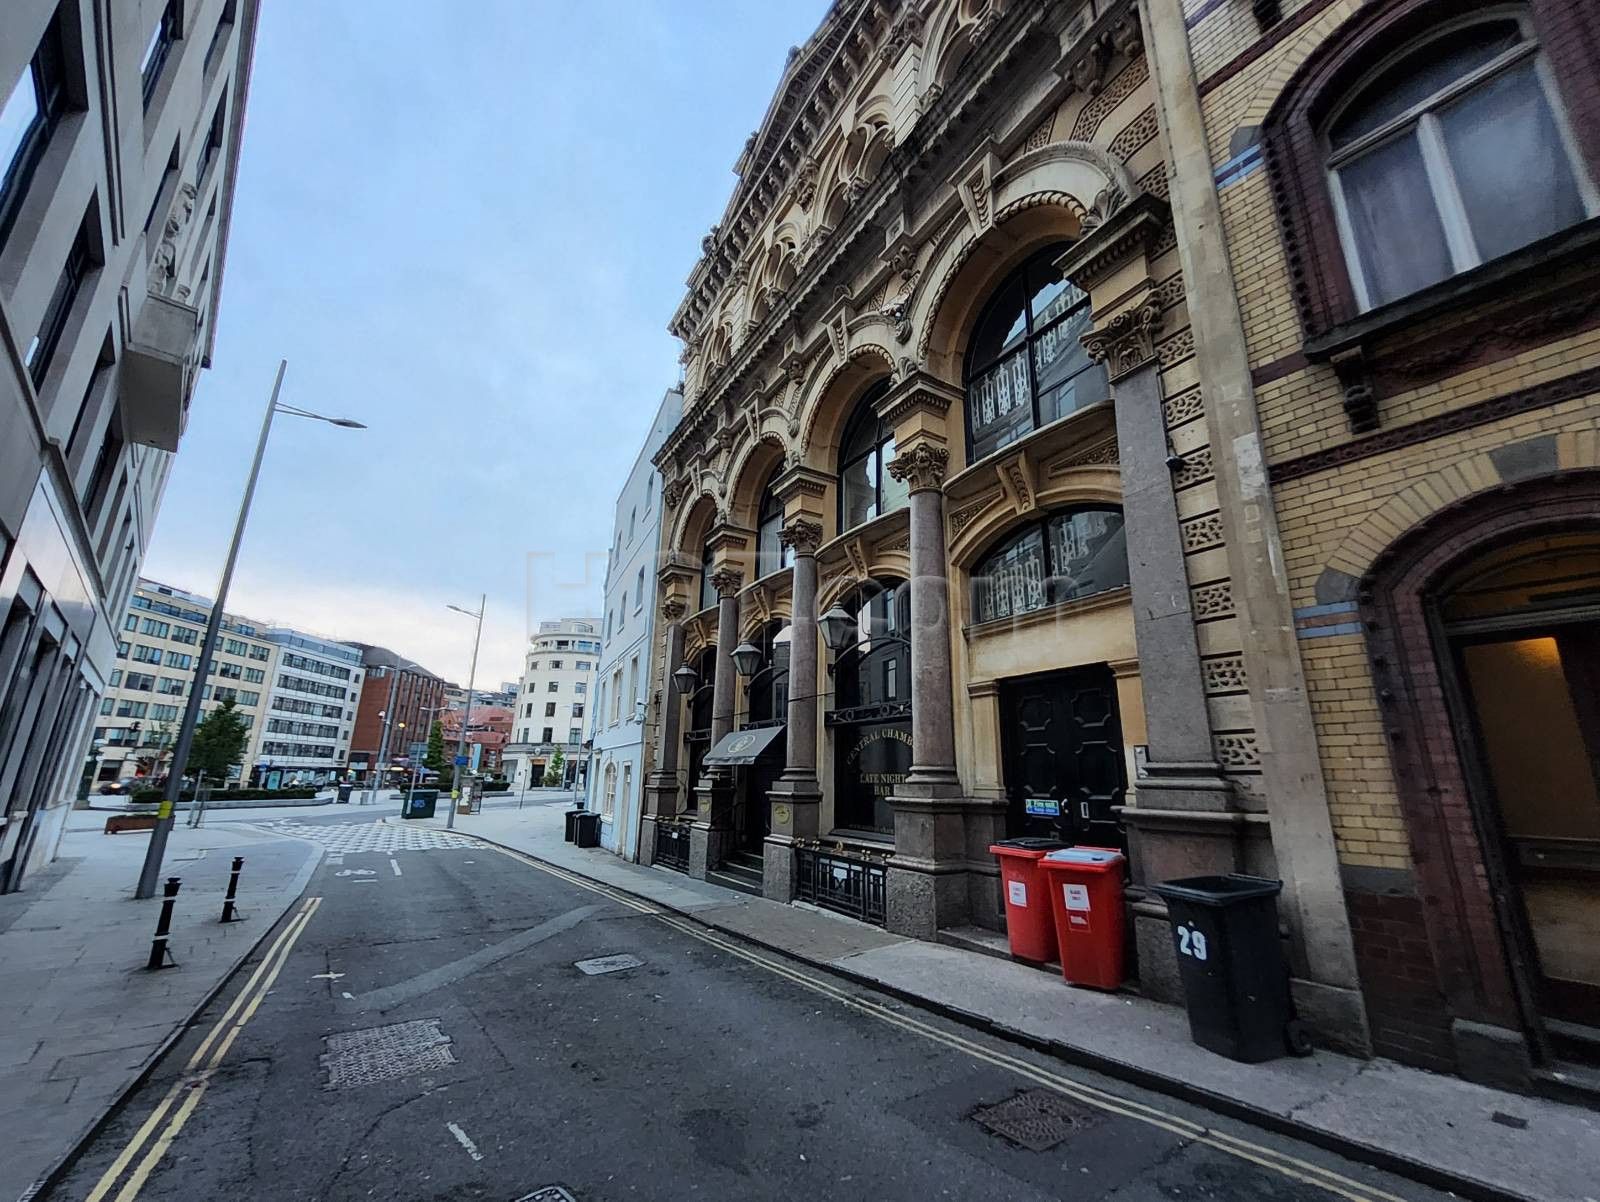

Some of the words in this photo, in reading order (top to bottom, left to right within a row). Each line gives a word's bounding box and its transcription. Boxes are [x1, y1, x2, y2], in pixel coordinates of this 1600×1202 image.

[846, 729, 881, 765] CENTRAL
[881, 728, 913, 747] CHAMB
[859, 773, 879, 784] LATE
[880, 773, 907, 784] NIGHT
[873, 785, 891, 796] BAR
[1177, 925, 1207, 961] 29
